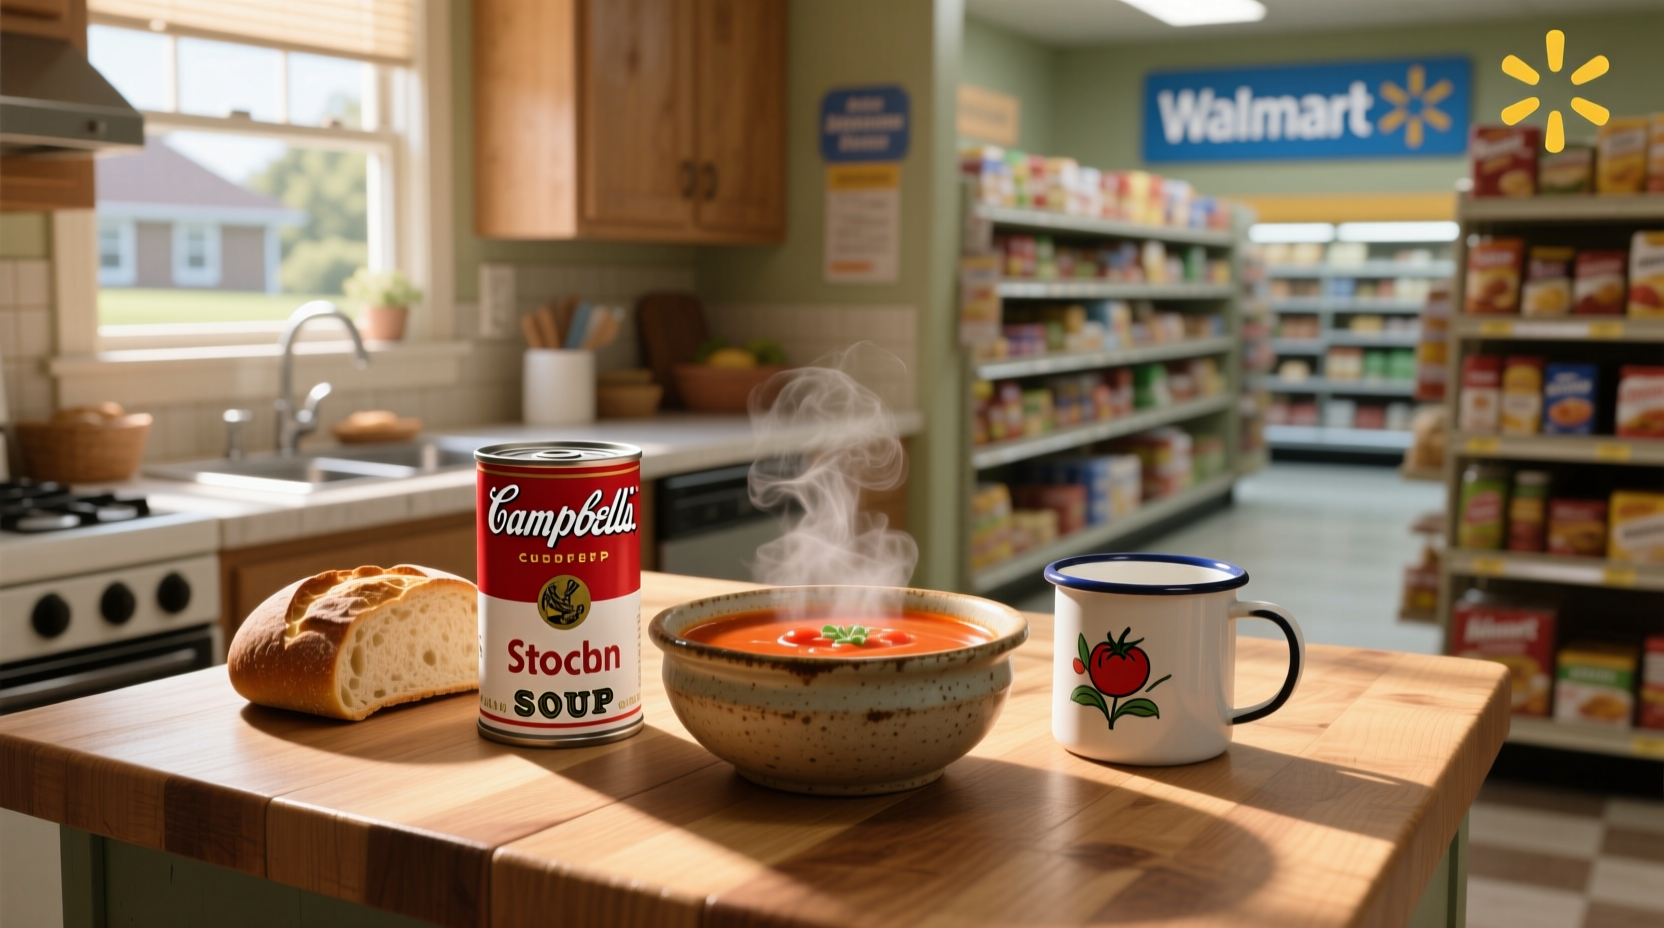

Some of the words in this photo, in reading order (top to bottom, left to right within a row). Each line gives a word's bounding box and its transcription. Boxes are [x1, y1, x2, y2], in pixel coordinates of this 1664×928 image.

[1158, 81, 1373, 144] Walmart
[508, 639, 620, 676] Stocbn
[514, 687, 613, 719] SOUP
